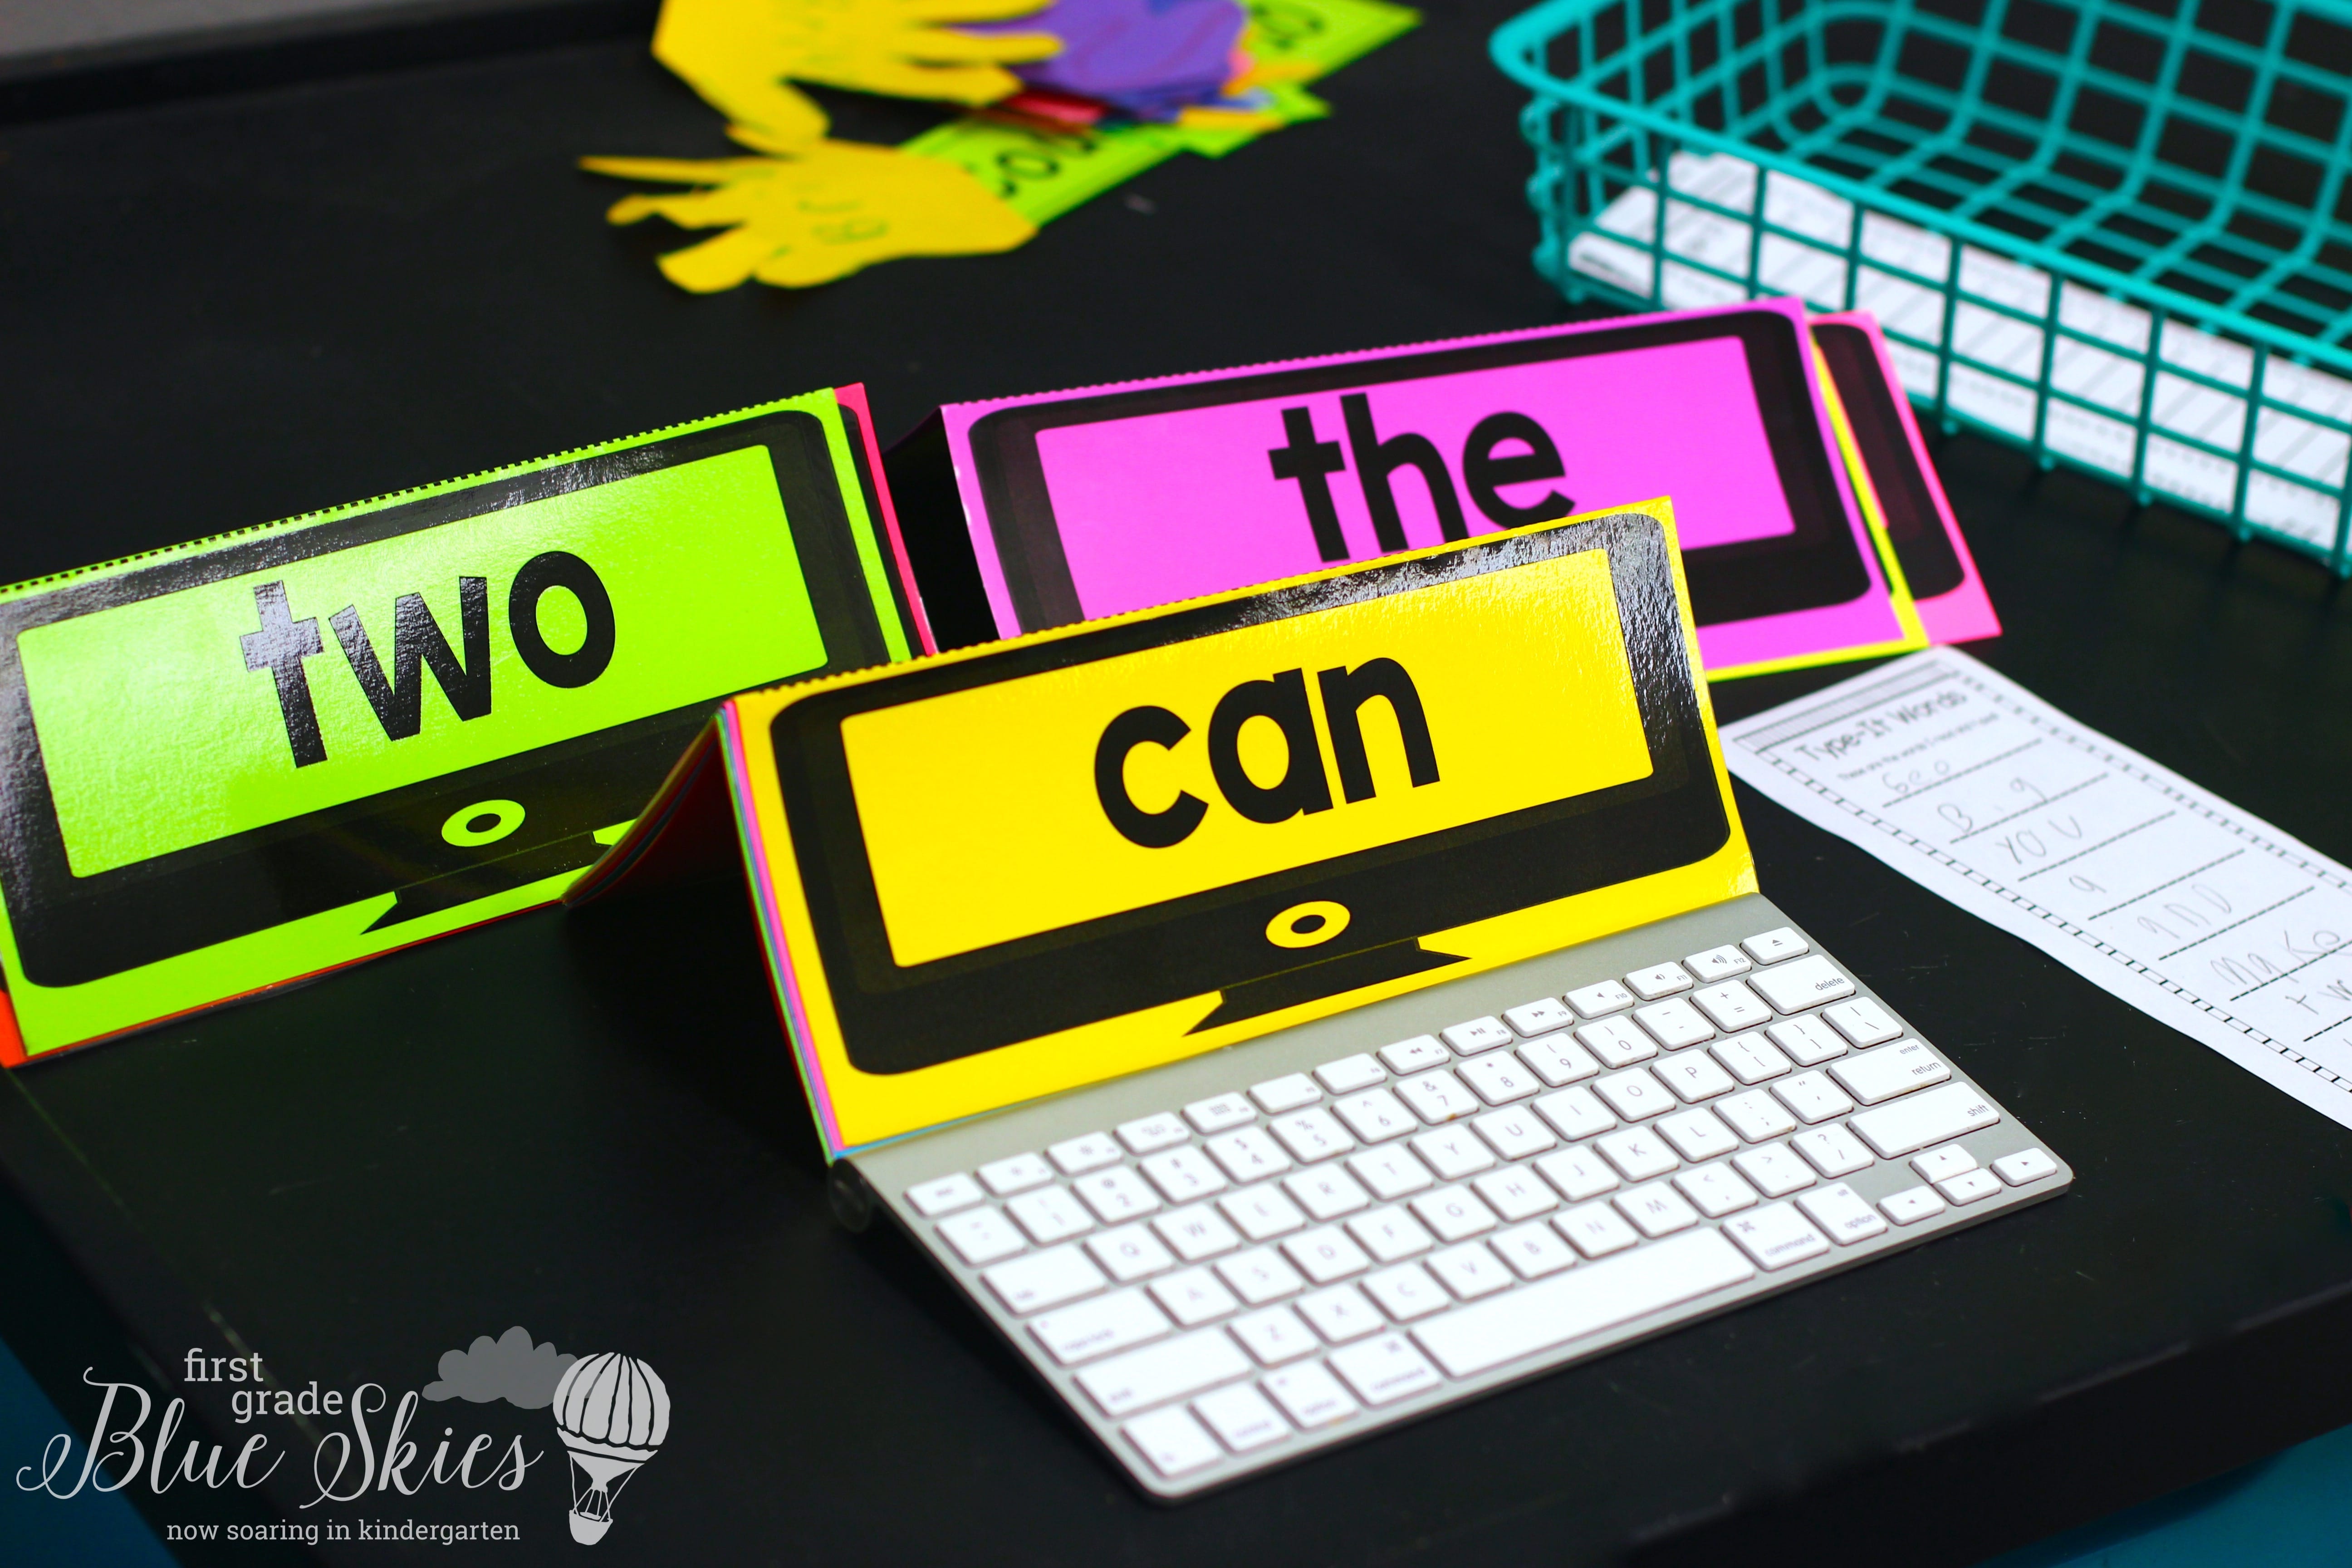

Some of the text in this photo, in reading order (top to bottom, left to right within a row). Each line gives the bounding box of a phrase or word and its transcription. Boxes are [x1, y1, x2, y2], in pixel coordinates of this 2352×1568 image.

[1267, 391, 1574, 563] the
[240, 550, 616, 769] two
[1793, 691, 1968, 760] Type-It Words
[1094, 657, 1441, 849] can
[1733, 955, 1748, 965] F12
[1676, 972, 1690, 981] F11
[1815, 976, 1845, 991] delete
[1615, 990, 1629, 1000] F10
[1899, 1044, 1920, 1055] enter
[1559, 1058, 1572, 1069] 9
[1911, 1061, 1942, 1077] return
[1685, 1067, 1697, 1078] P
[1500, 1076, 1514, 1088] 8
[1967, 1103, 1989, 1117] shift
[1505, 1123, 1524, 1137] U
[1628, 1143, 1646, 1157] K
[1843, 1214, 1877, 1230] option
[1763, 1233, 1816, 1257] command
